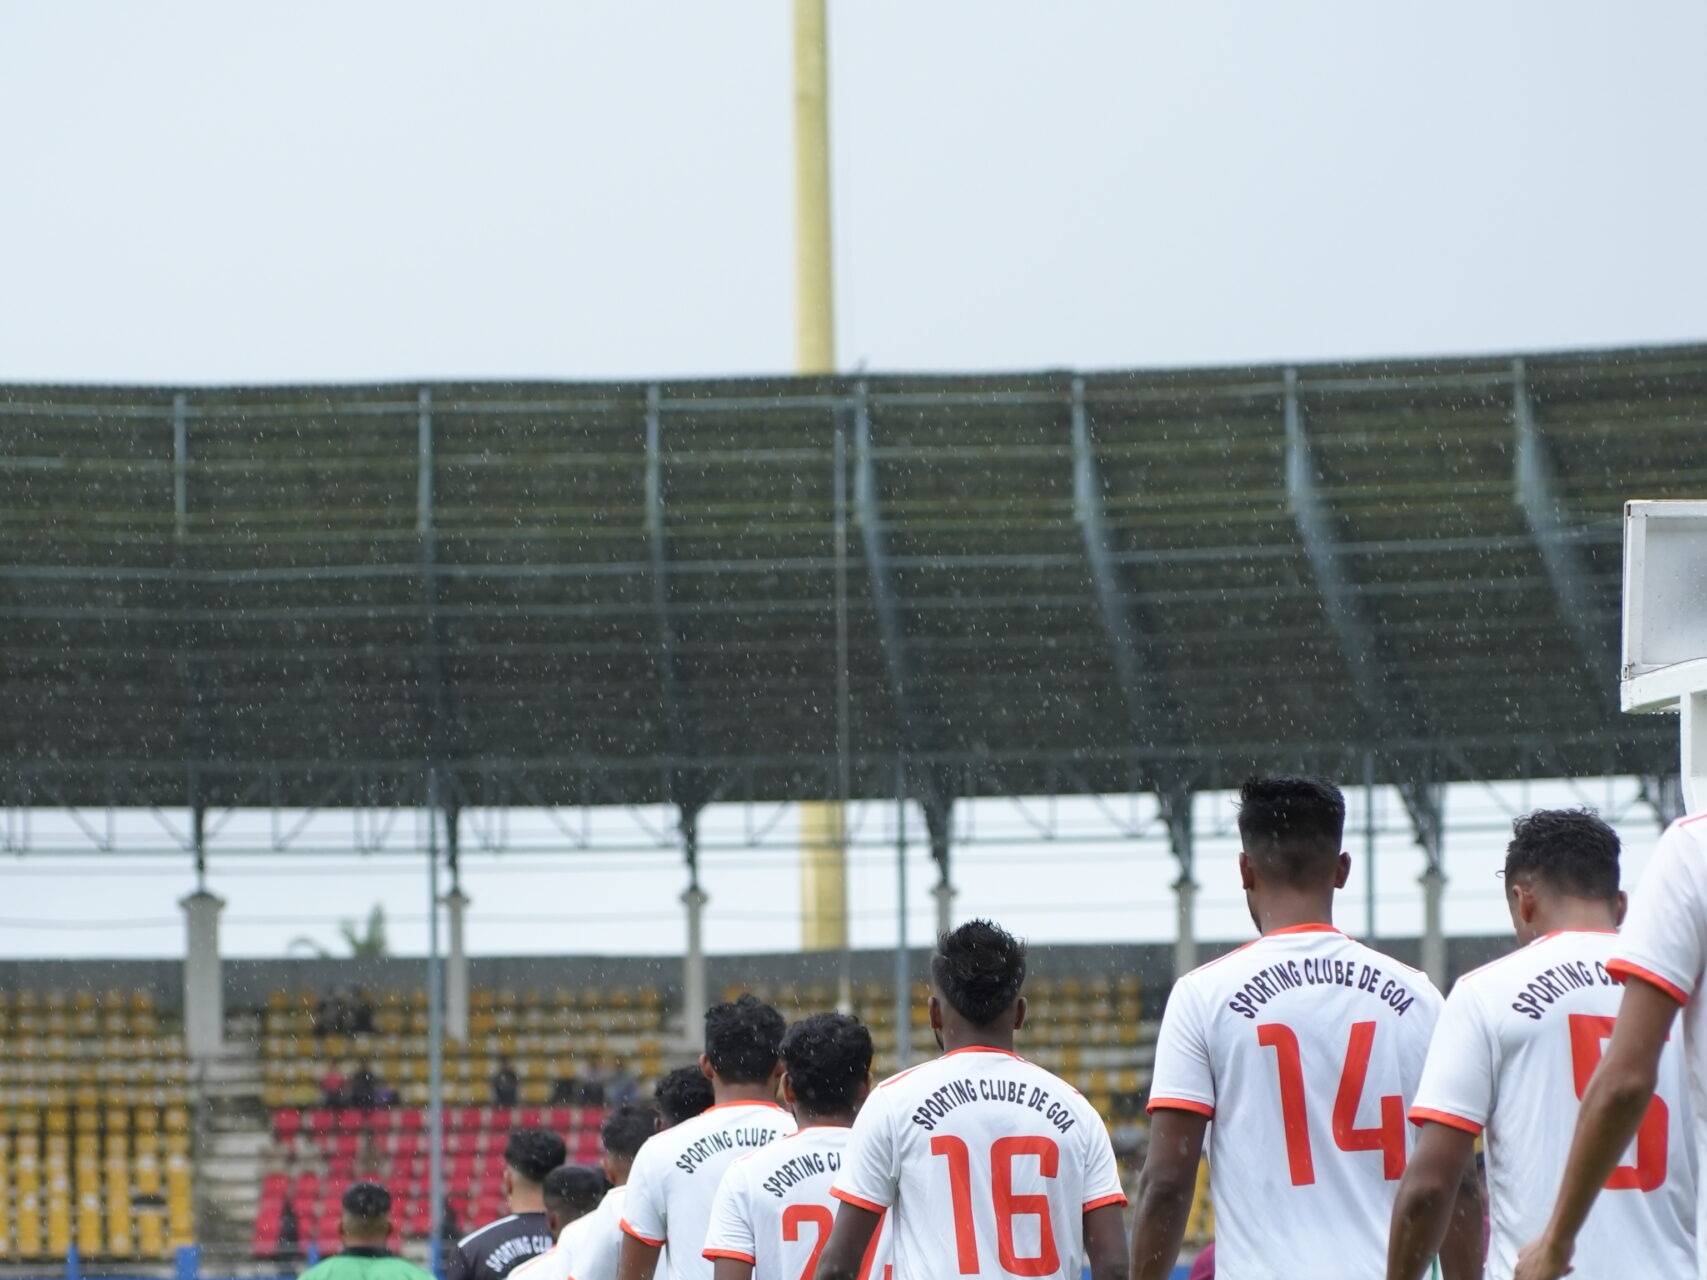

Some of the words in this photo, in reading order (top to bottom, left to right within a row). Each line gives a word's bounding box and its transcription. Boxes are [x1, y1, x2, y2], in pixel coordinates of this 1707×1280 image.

[1229, 960, 1302, 1019] SPORTING
[1304, 958, 1355, 987] CLUBE
[1358, 965, 1381, 993] DE
[1380, 980, 1415, 1016] GOA
[1512, 960, 1594, 1020] SPORTING
[912, 1079, 978, 1131] SPORTING
[980, 1079, 1027, 1104] CLUBE
[1028, 1087, 1049, 1112] DE
[1046, 1102, 1075, 1134] GOA
[1257, 1021, 1407, 1186] 14
[676, 1130, 733, 1174] SPORTING
[763, 1152, 825, 1198] SPORTING
[930, 1135, 1060, 1277] 16
